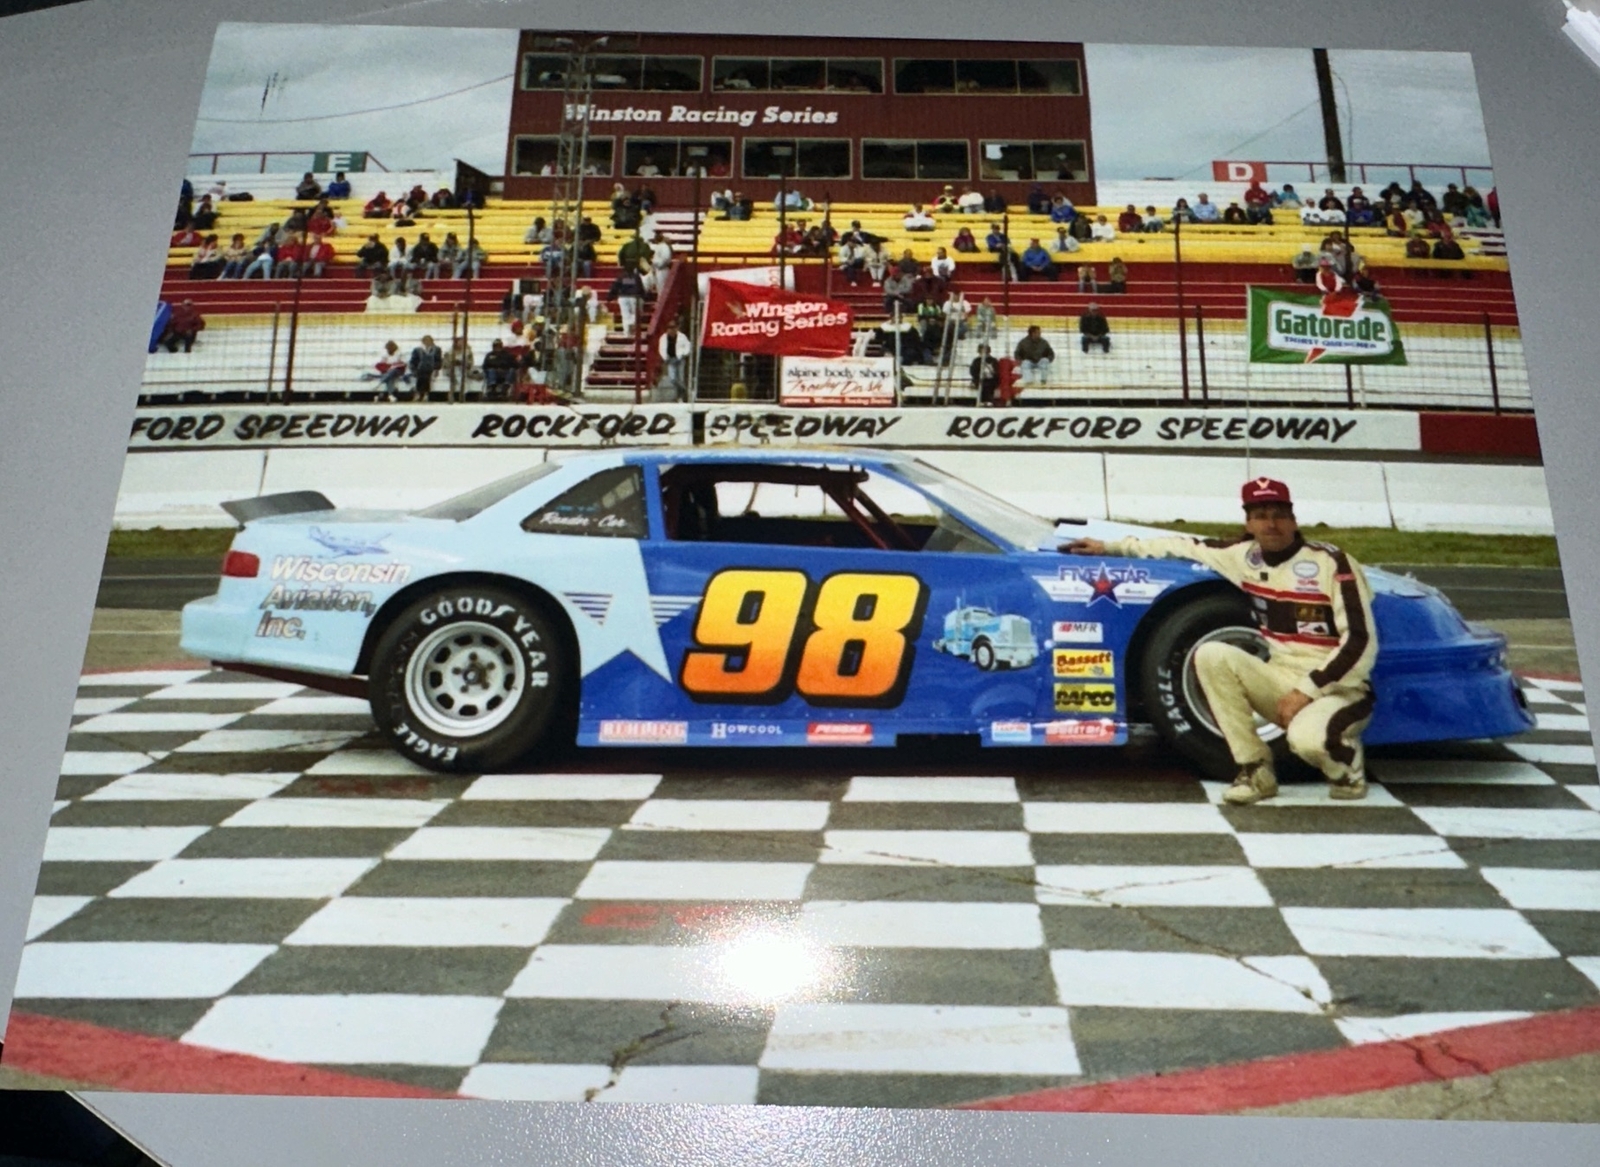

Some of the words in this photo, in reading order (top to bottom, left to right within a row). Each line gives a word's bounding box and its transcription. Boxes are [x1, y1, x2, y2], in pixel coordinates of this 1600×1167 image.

[565, 104, 662, 122] Winston
[668, 105, 756, 127] Racing
[762, 106, 839, 124] Series
[327, 154, 352, 172] E
[1228, 163, 1254, 181] D
[744, 301, 828, 318] Winston
[711, 320, 780, 337] Racing
[783, 312, 848, 331] Series
[1275, 308, 1387, 342] Gatorade
[233, 413, 438, 440] SPEEDWAY
[472, 412, 677, 439] ROCKFORD
[709, 412, 903, 439] SPEEDWAY
[946, 415, 1142, 440] ROCKFORD
[1156, 415, 1357, 443] SPEEDWAY
[270, 554, 411, 584] Wisconsin
[259, 583, 377, 618] Aviation,
[420, 596, 549, 689] GOODYEAR
[678, 566, 931, 710] 98
[1157, 666, 1192, 733] EAGLE
[393, 723, 459, 762] EAGLE
